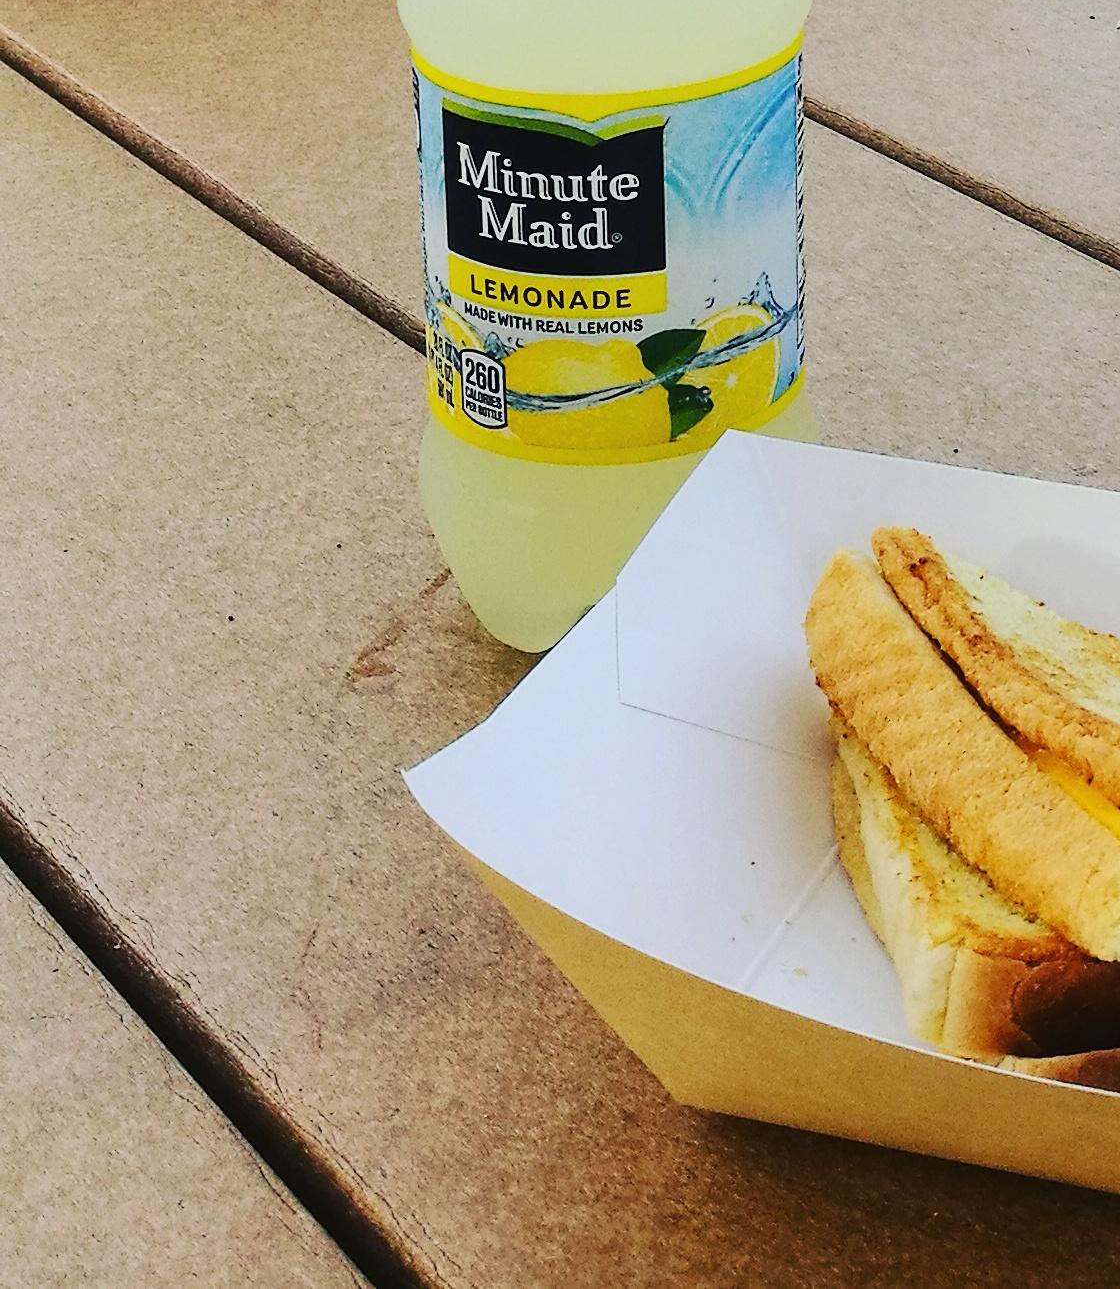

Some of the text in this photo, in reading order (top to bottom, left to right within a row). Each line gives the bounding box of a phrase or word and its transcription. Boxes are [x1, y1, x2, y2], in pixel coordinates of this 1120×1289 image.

[456, 141, 640, 202] Minute
[470, 273, 632, 310] LEMONADE
[464, 301, 644, 335] MADE WITH REAL LEMONS
[465, 357, 500, 394] 260
[465, 385, 502, 409] CALORIES
